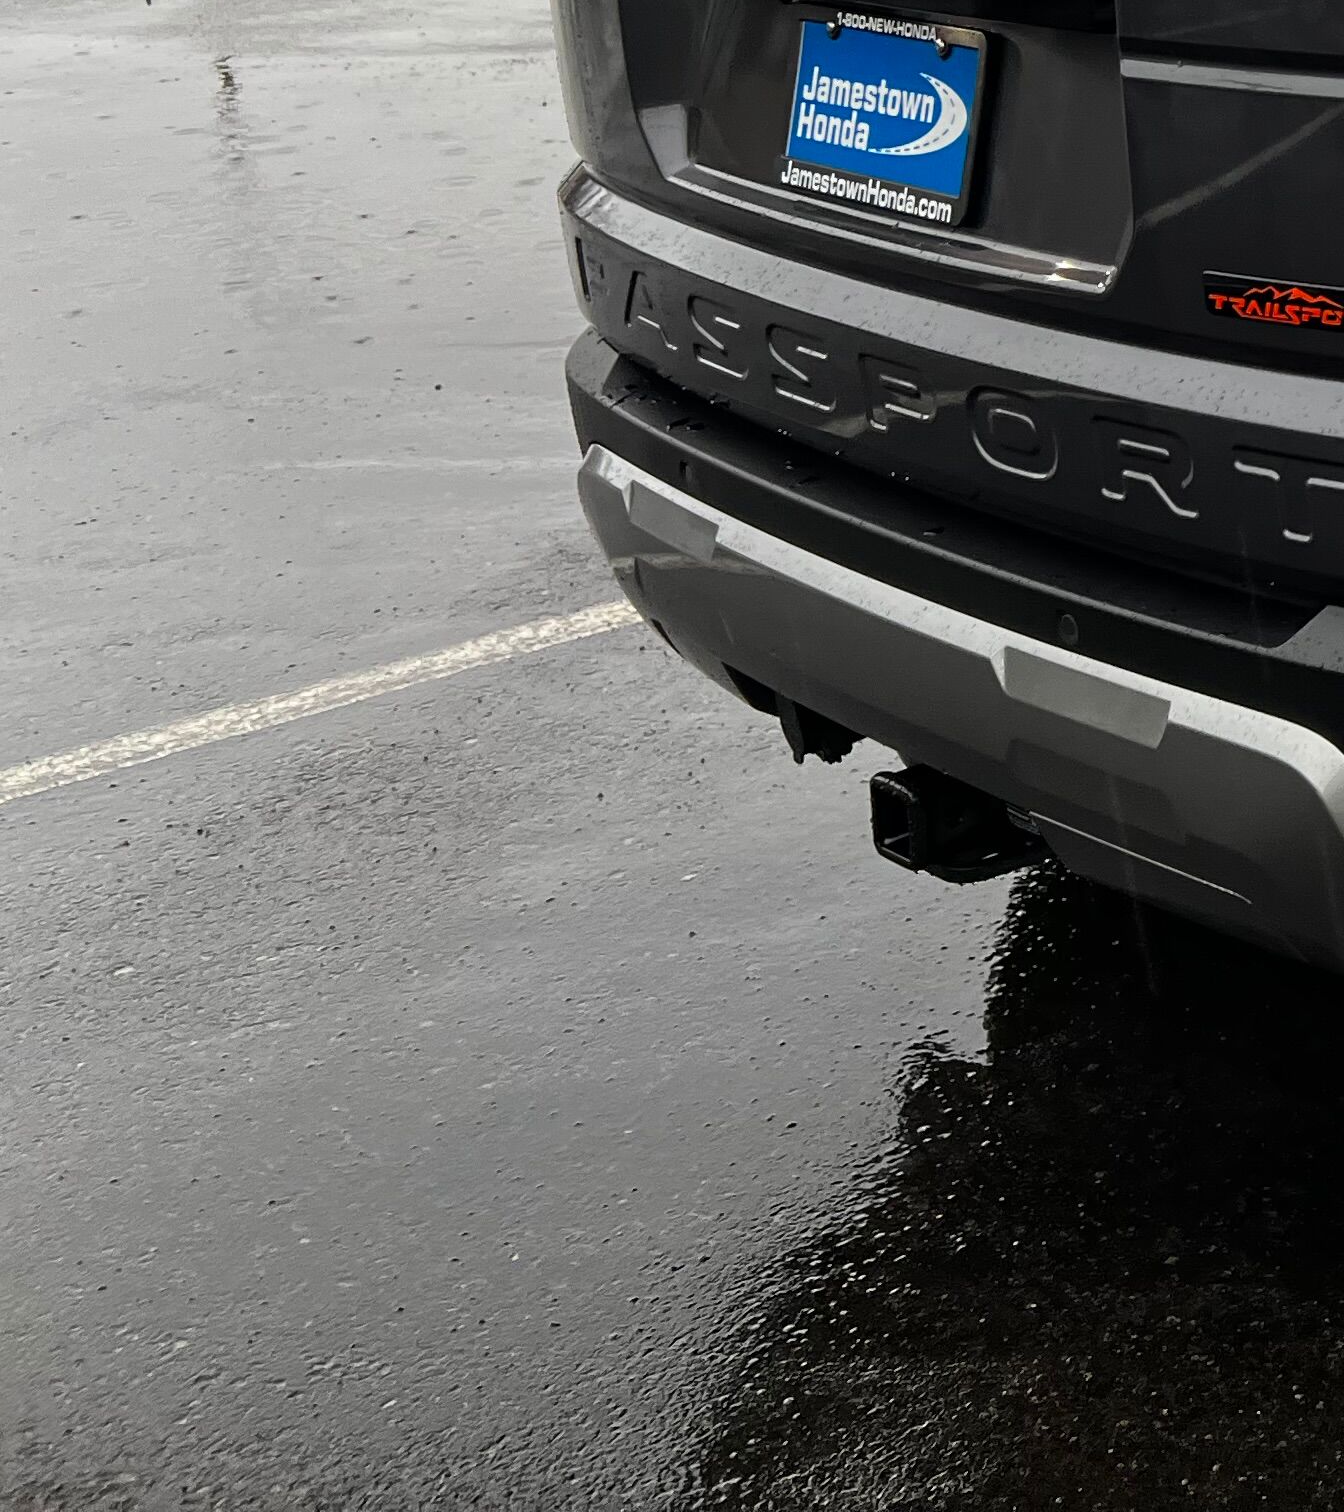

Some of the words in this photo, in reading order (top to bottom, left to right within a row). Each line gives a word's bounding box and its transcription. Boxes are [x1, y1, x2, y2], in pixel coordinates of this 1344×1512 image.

[836, 11, 938, 41] 1-800-NEW-HONDA
[803, 66, 935, 123] Jamestown
[796, 102, 870, 152] Honda
[781, 160, 952, 224] JamestownHonda.com
